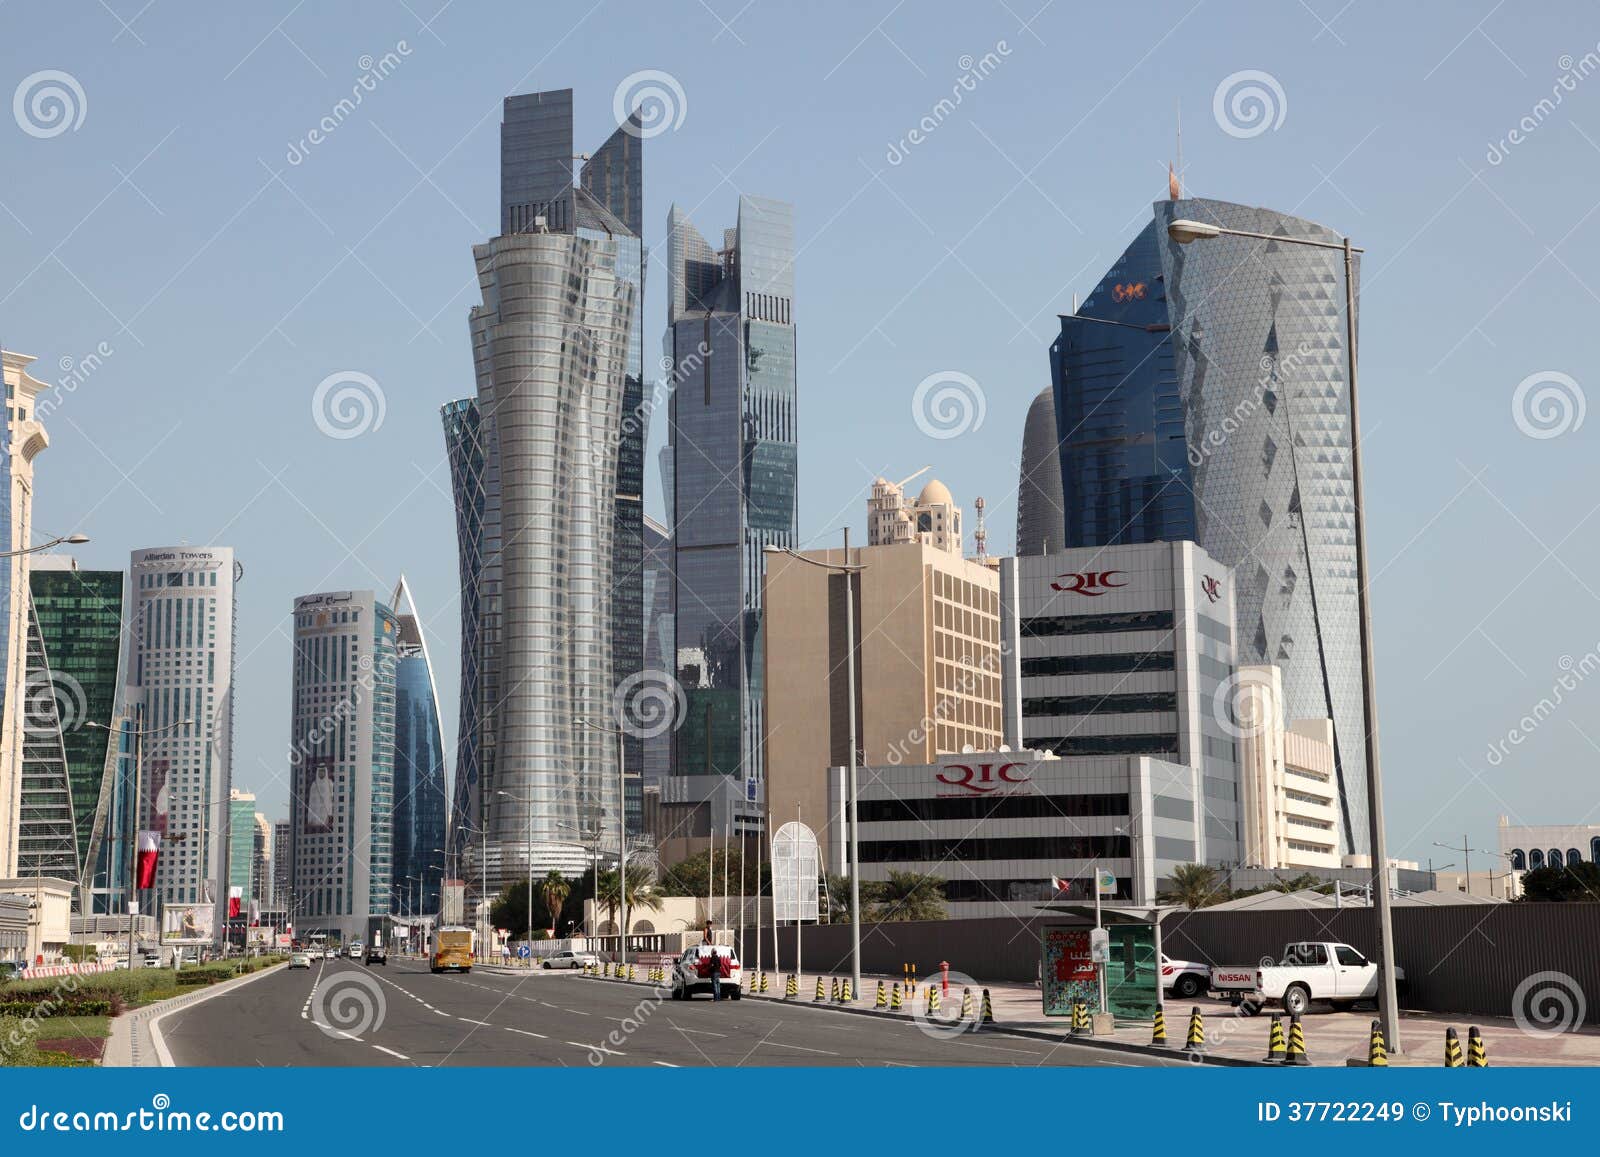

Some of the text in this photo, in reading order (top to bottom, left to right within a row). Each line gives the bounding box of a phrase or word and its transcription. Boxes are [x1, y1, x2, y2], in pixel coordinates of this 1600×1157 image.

[180, 551, 213, 560] Towers
[1050, 570, 1130, 597] QIC
[936, 762, 1032, 793] QIC
[1218, 974, 1251, 982] NISSAN
